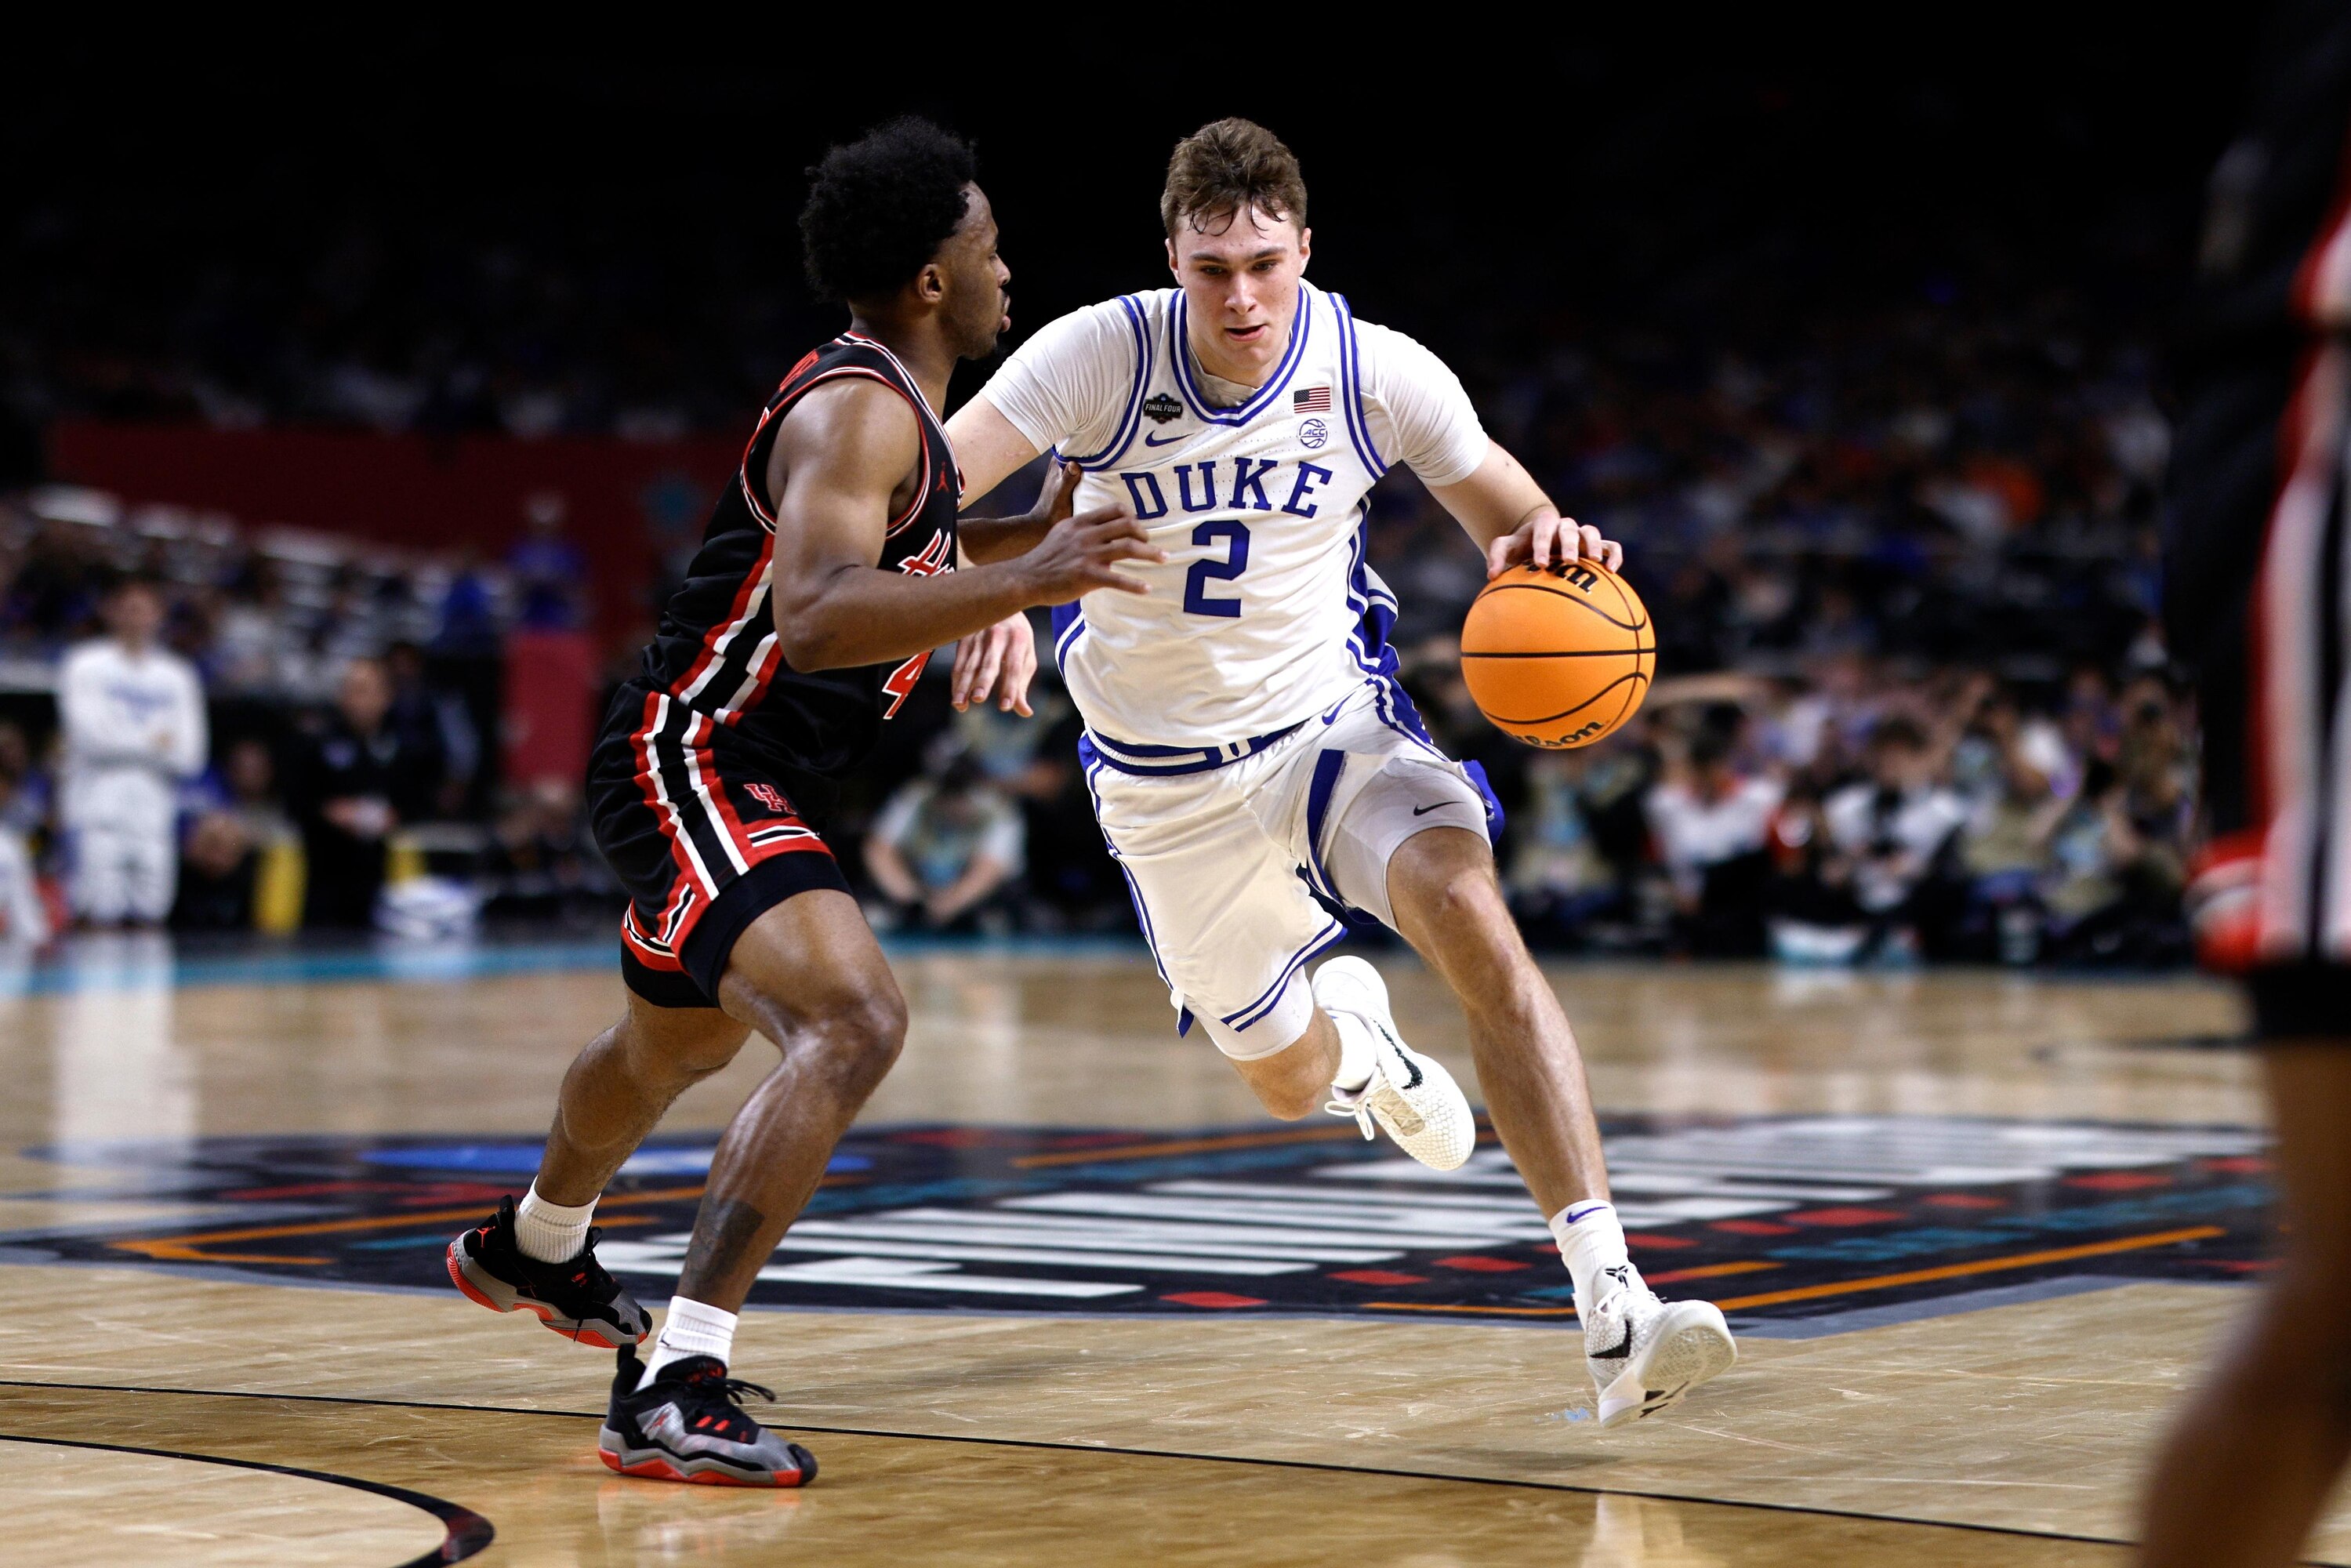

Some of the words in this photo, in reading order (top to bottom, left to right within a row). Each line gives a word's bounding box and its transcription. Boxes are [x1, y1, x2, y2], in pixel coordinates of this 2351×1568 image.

[1145, 403, 1163, 412] FINAL
[1163, 405, 1181, 413] FOUR
[1119, 457, 1333, 520] DUKE
[1183, 520, 1250, 618] 2
